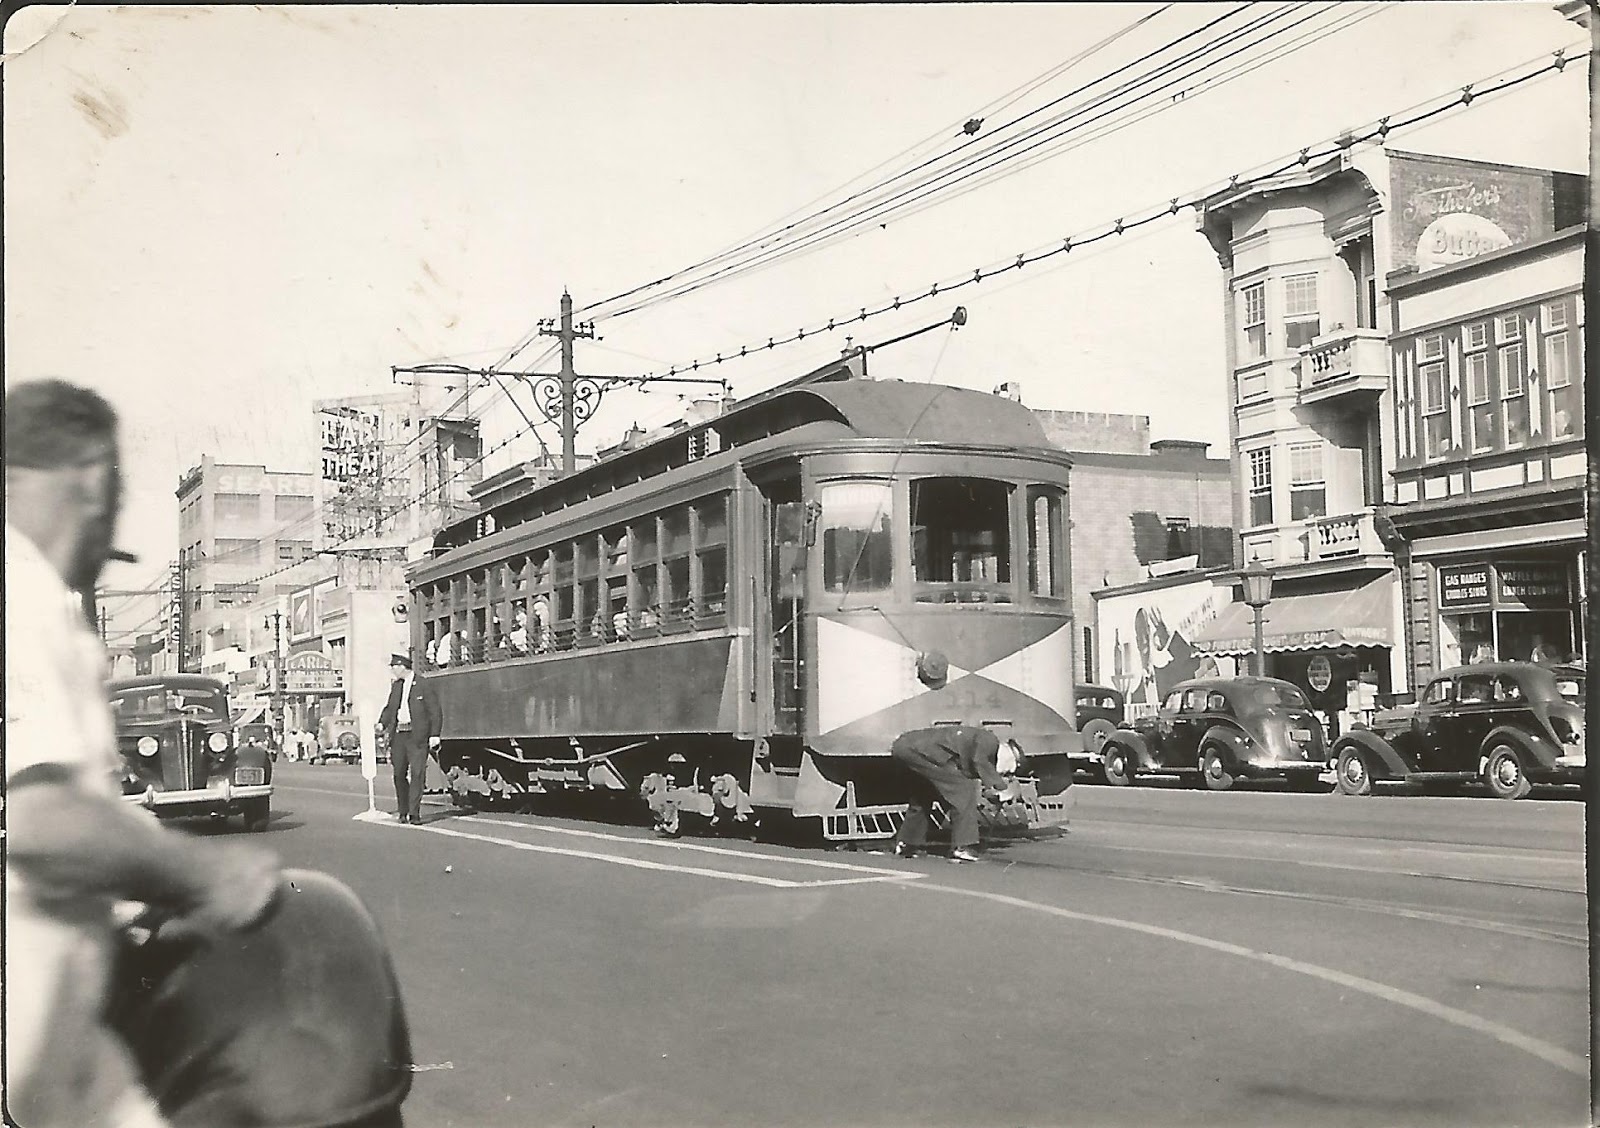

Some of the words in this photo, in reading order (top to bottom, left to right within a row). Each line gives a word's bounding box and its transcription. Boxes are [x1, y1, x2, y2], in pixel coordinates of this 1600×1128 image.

[217, 475, 313, 493] SEARS
[1445, 575, 1459, 586] GAS
[1461, 572, 1487, 585] RANGES
[290, 656, 330, 669] EARLE
